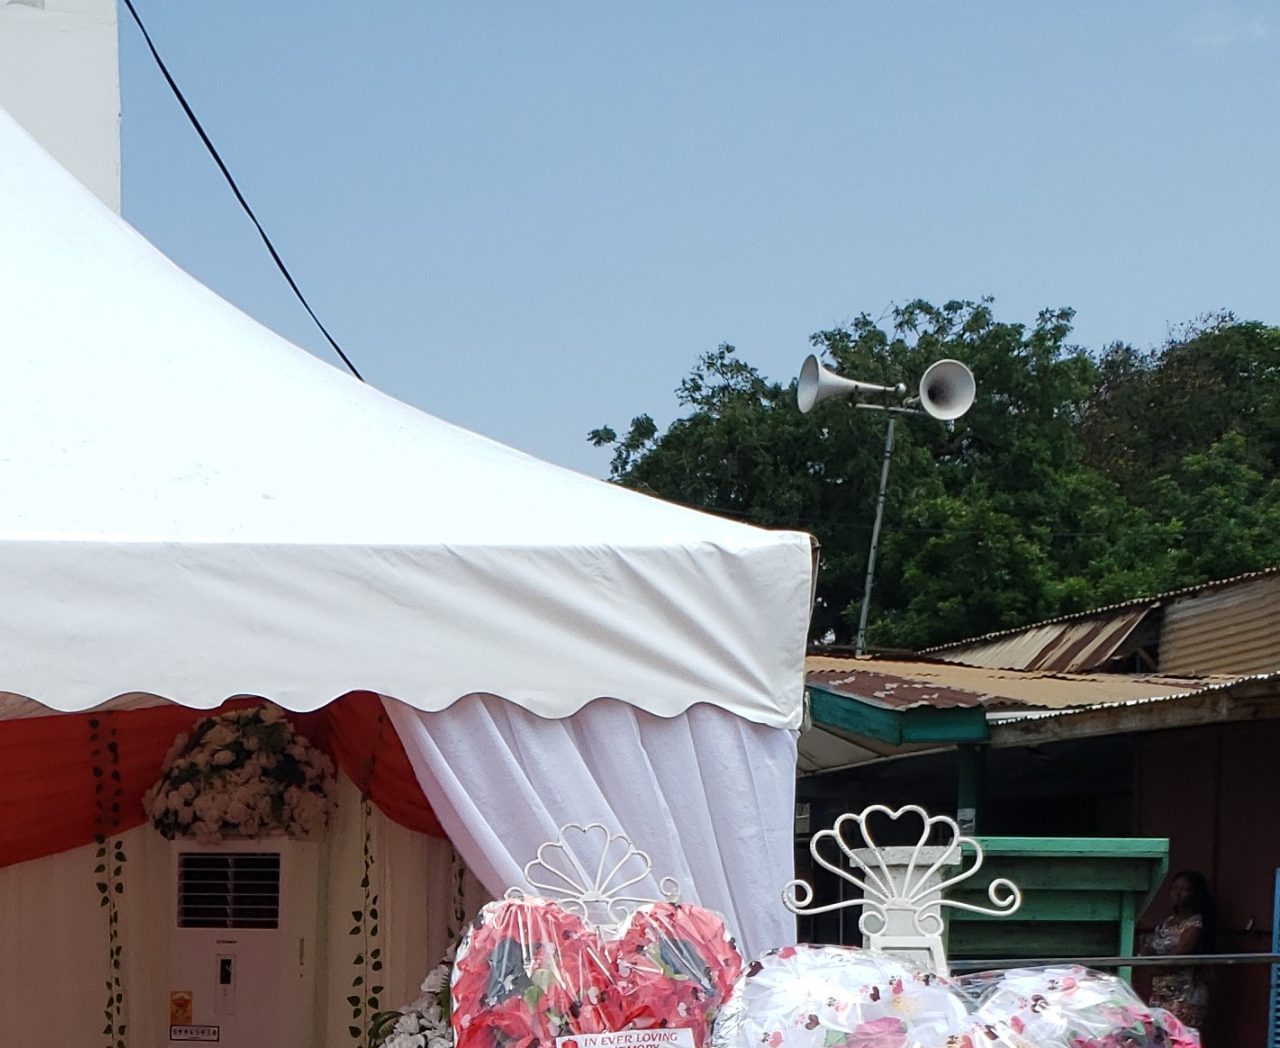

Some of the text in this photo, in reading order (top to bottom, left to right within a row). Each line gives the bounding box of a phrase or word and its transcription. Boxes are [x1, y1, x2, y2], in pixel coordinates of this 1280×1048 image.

[584, 1033, 678, 1047] IN EVER LOVING
